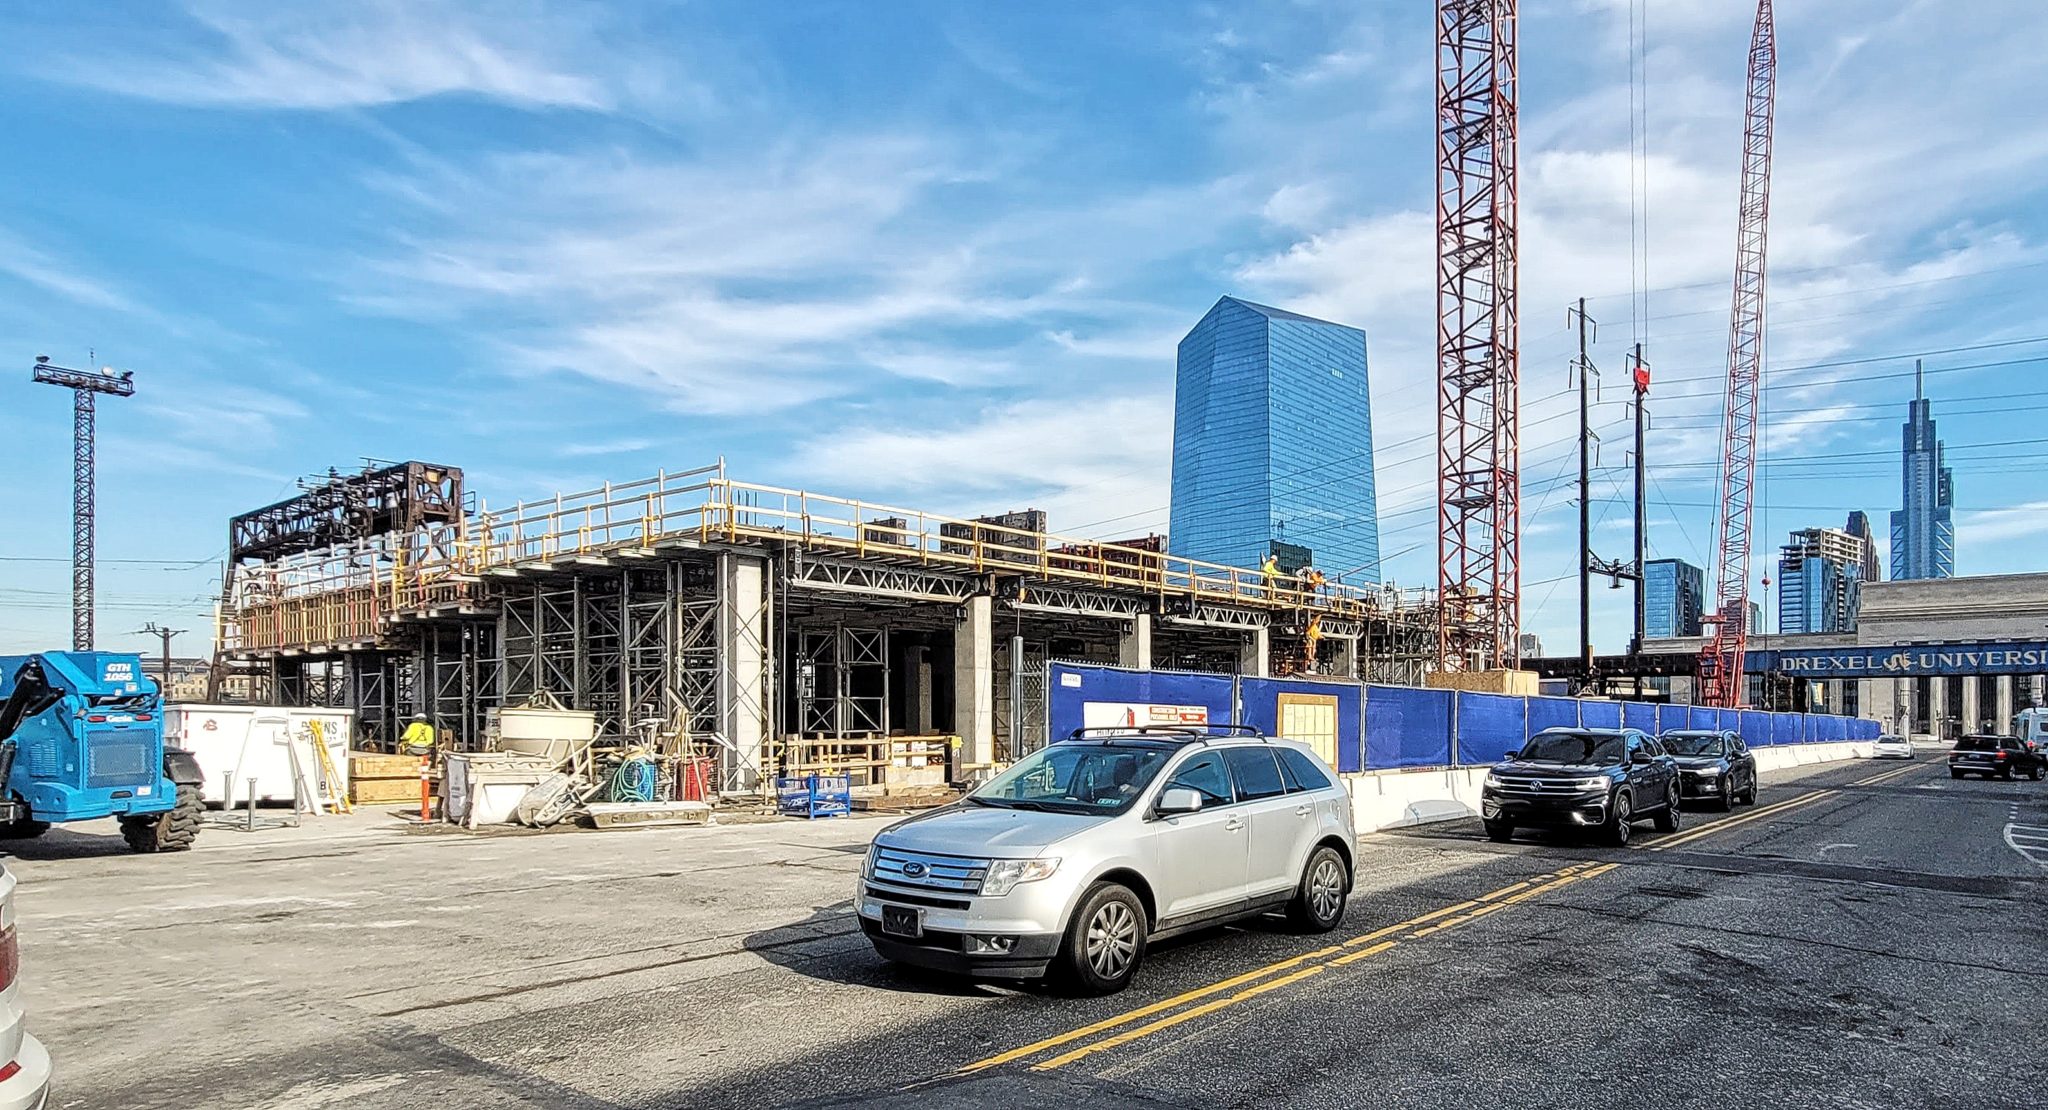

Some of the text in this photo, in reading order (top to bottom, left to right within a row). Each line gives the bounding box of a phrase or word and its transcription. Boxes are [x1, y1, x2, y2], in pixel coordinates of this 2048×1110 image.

[107, 663, 132, 672] GTH
[1780, 655, 1882, 671] DREXEL
[103, 672, 134, 682] 1056
